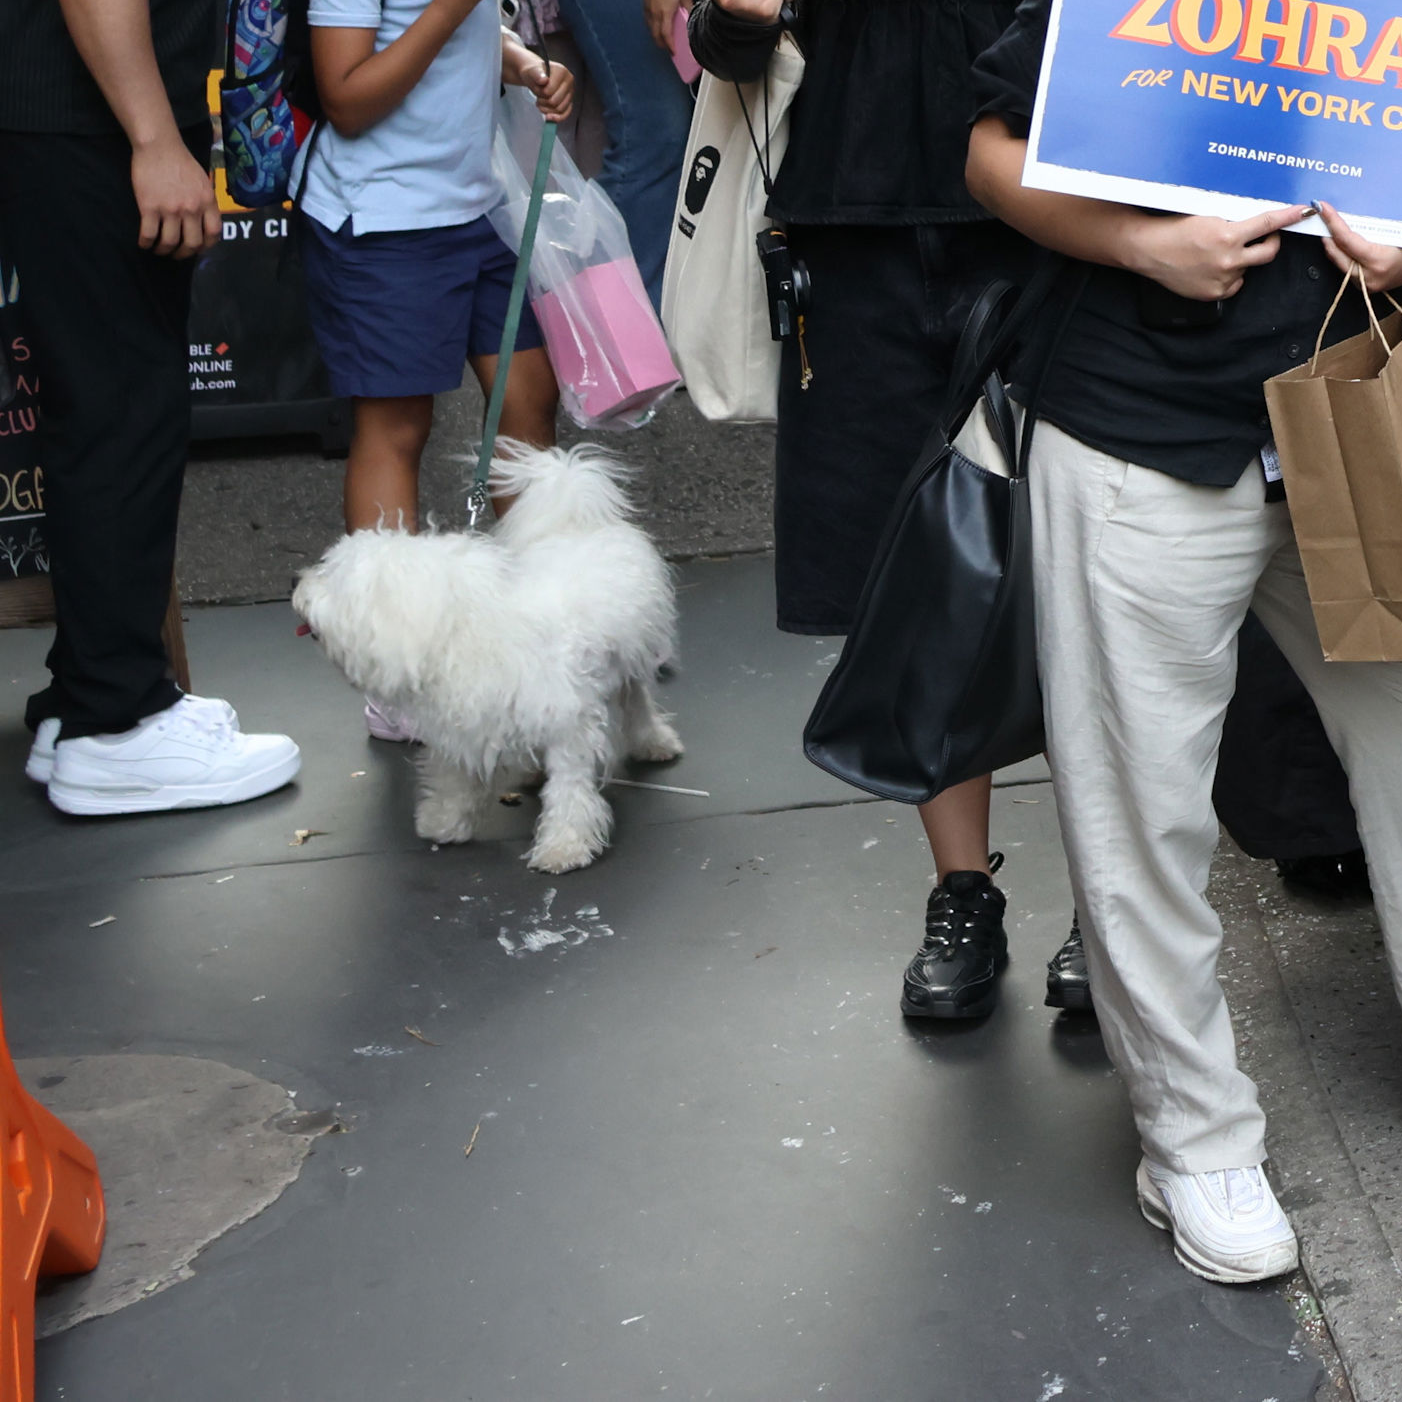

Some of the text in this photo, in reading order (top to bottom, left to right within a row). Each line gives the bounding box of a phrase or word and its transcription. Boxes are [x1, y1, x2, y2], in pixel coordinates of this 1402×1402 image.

[1121, 68, 1168, 88] FOR
[1181, 69, 1268, 107] NEW
[1276, 86, 1374, 127] YORK
[1207, 142, 1363, 178] ZOHRANFORNYC.COM
